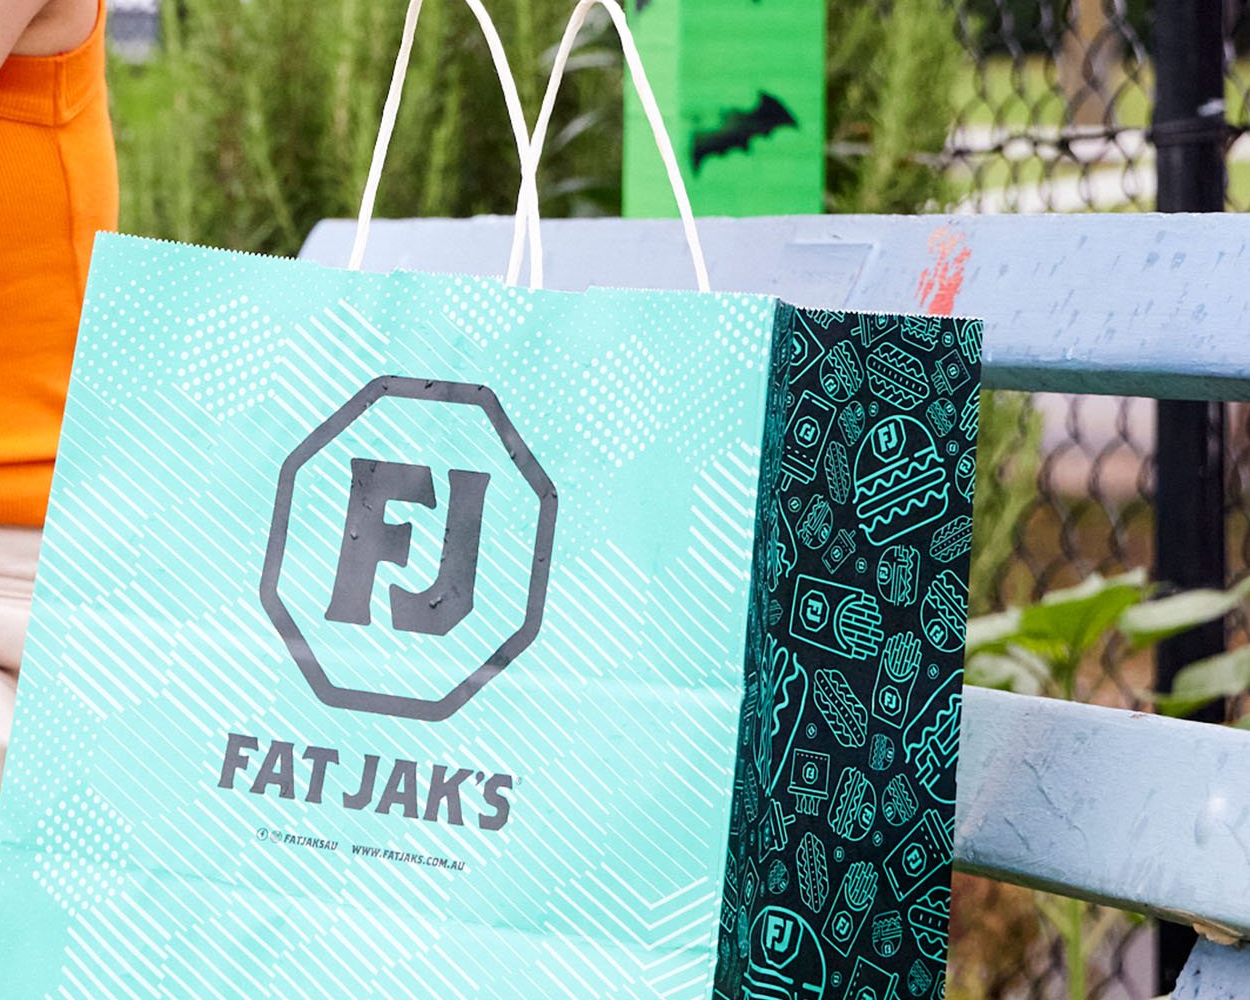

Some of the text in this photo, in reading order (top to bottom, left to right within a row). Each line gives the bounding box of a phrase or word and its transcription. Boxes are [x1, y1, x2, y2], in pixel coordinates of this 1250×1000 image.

[877, 422, 899, 453] FJ
[324, 457, 491, 637] FJ
[217, 732, 514, 832] FAT JAK'S
[283, 833, 466, 872] FATJAKSAU WWW.FATJAKS.COM.AU
[765, 914, 794, 953] FJ
